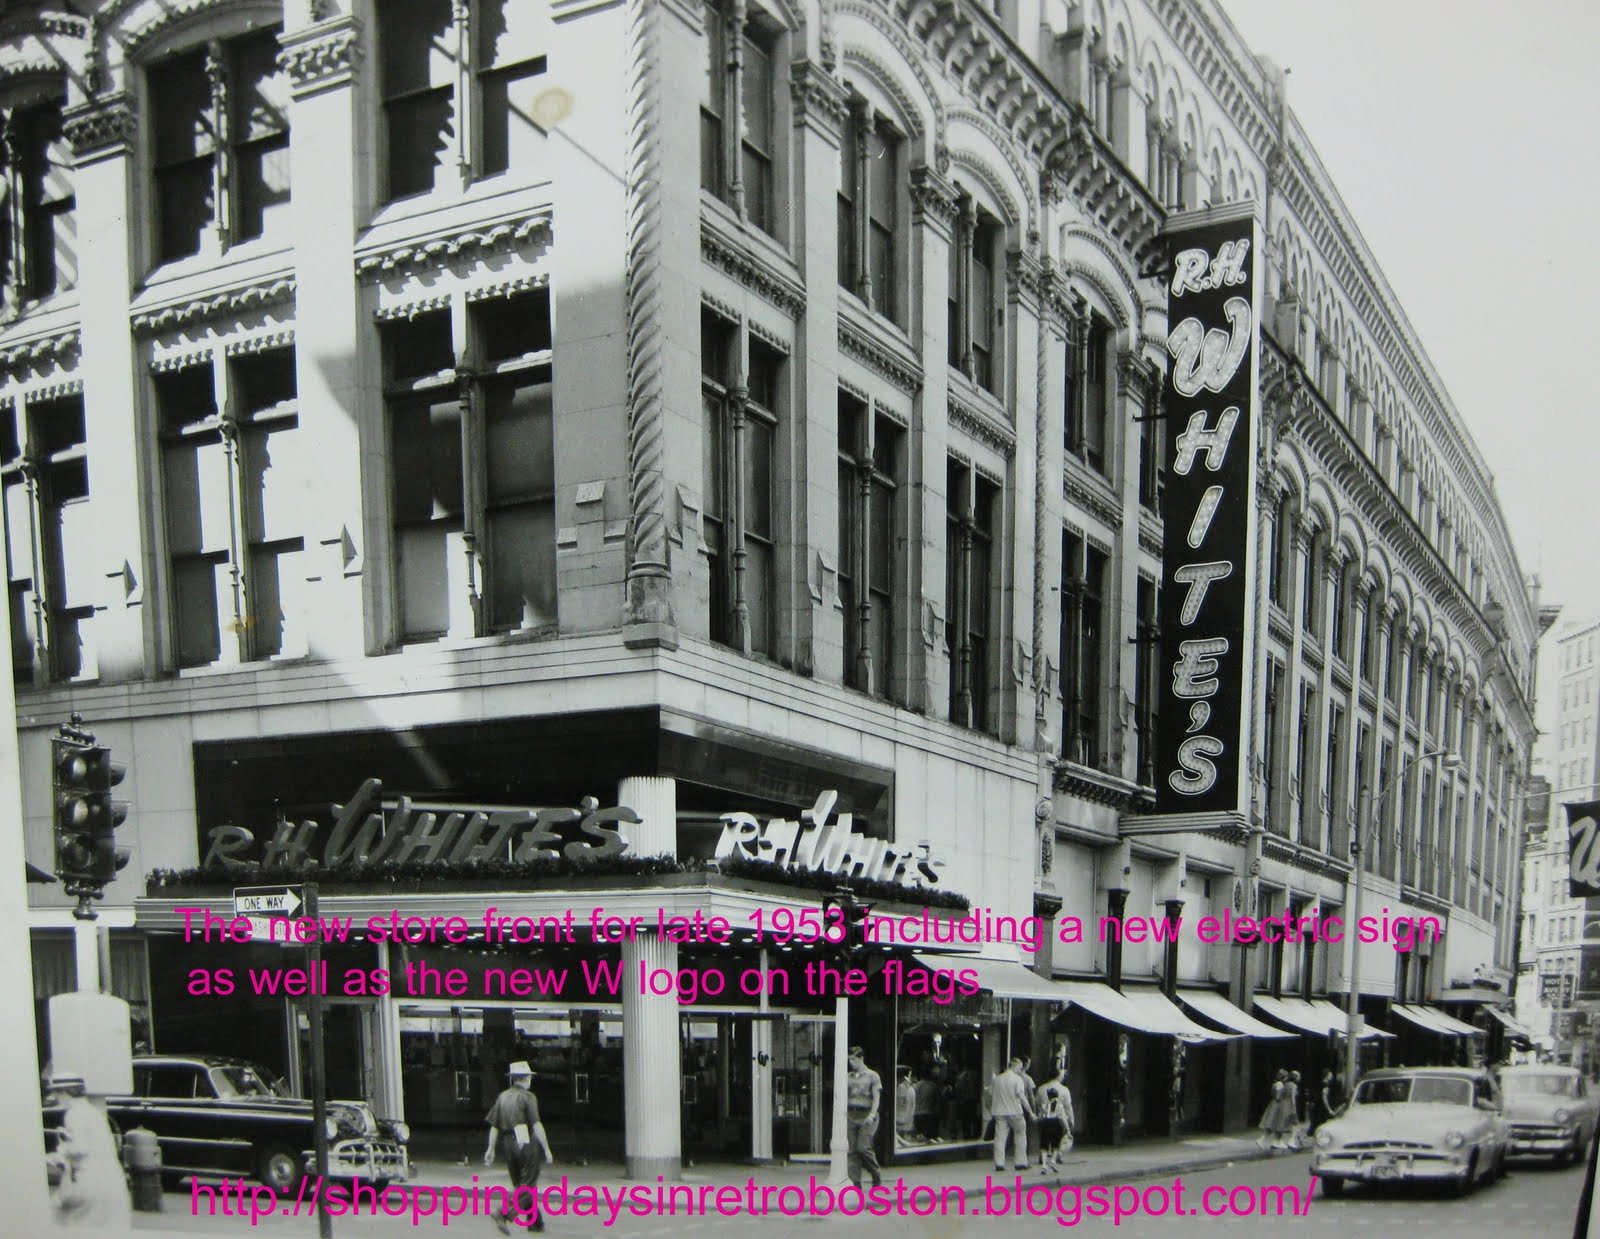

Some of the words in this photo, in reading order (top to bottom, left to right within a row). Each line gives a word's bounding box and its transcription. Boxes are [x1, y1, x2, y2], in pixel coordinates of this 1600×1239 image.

[1171, 238, 1250, 298] R.H.
[244, 897, 261, 910] ONE
[266, 896, 284, 909] WAY
